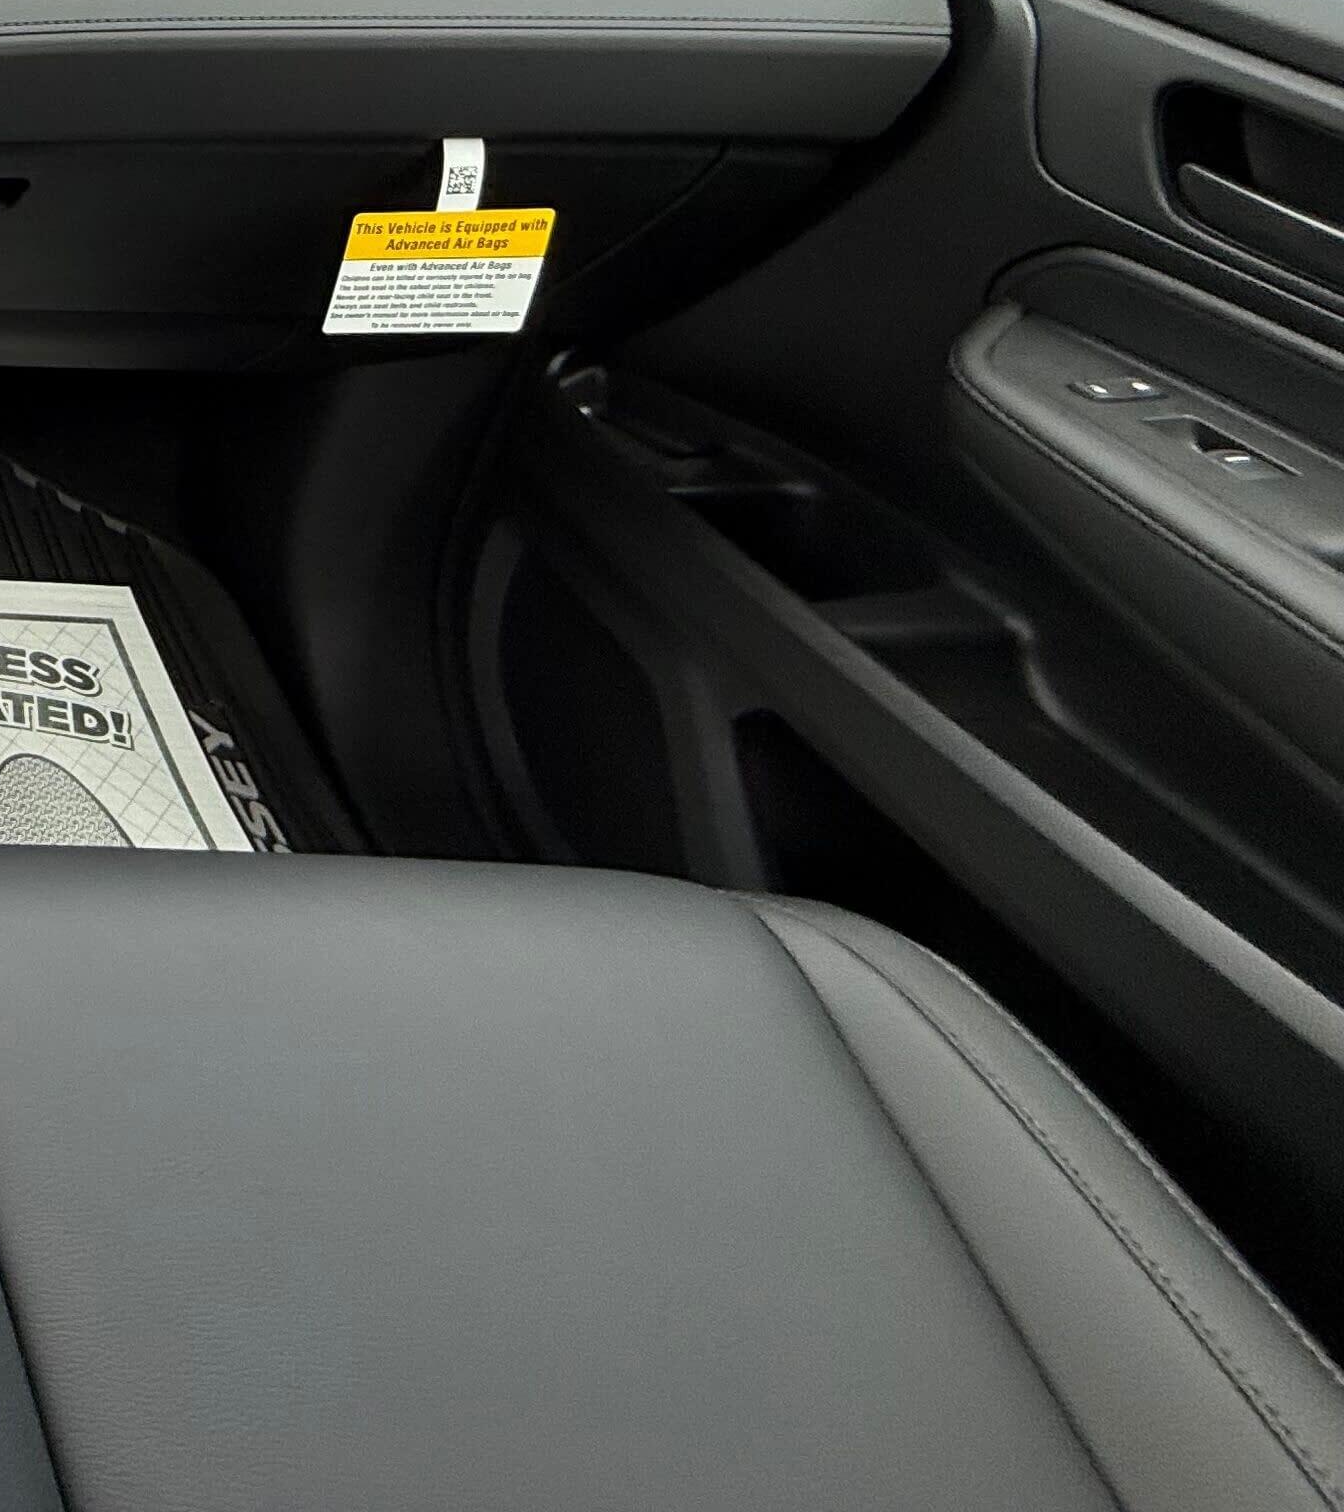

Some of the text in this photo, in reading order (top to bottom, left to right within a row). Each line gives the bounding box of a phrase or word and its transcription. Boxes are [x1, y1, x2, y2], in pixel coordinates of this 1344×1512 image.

[356, 218, 549, 237] This Vehicle is Equipped with
[385, 237, 510, 251] Advanced Air Bags
[370, 260, 513, 272] Even with Advanced Air Bags
